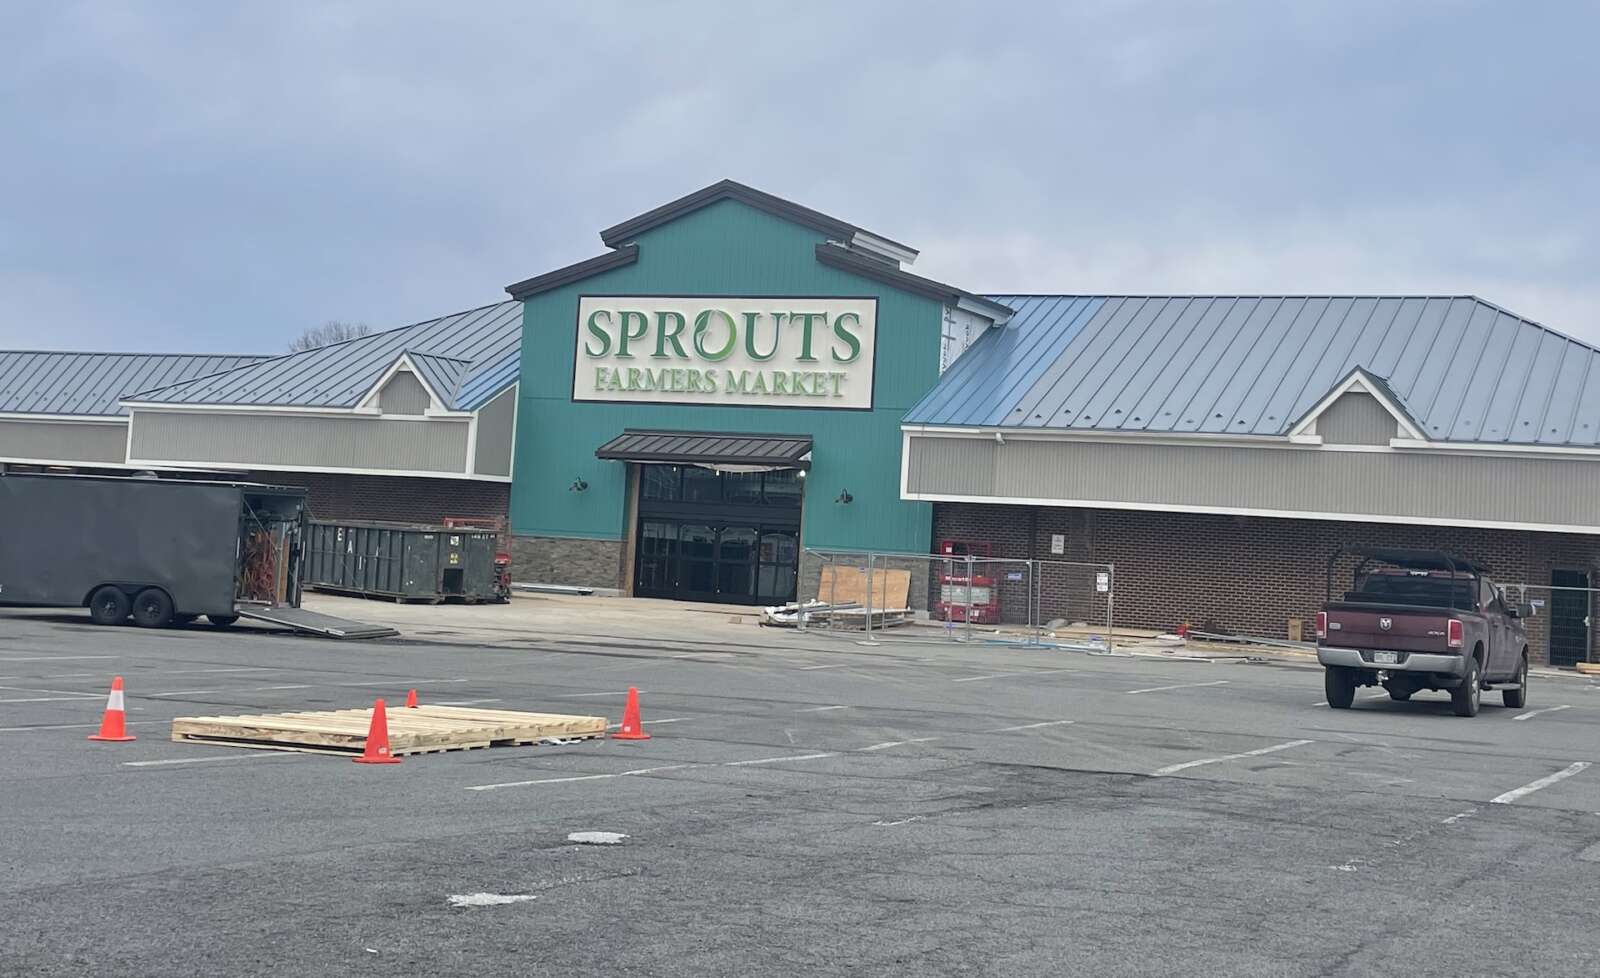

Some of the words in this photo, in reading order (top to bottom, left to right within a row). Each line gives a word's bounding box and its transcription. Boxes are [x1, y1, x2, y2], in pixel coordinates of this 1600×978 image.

[585, 309, 861, 361] SPROUTS
[594, 366, 717, 393] FARMERS
[724, 370, 848, 397] MARKET
